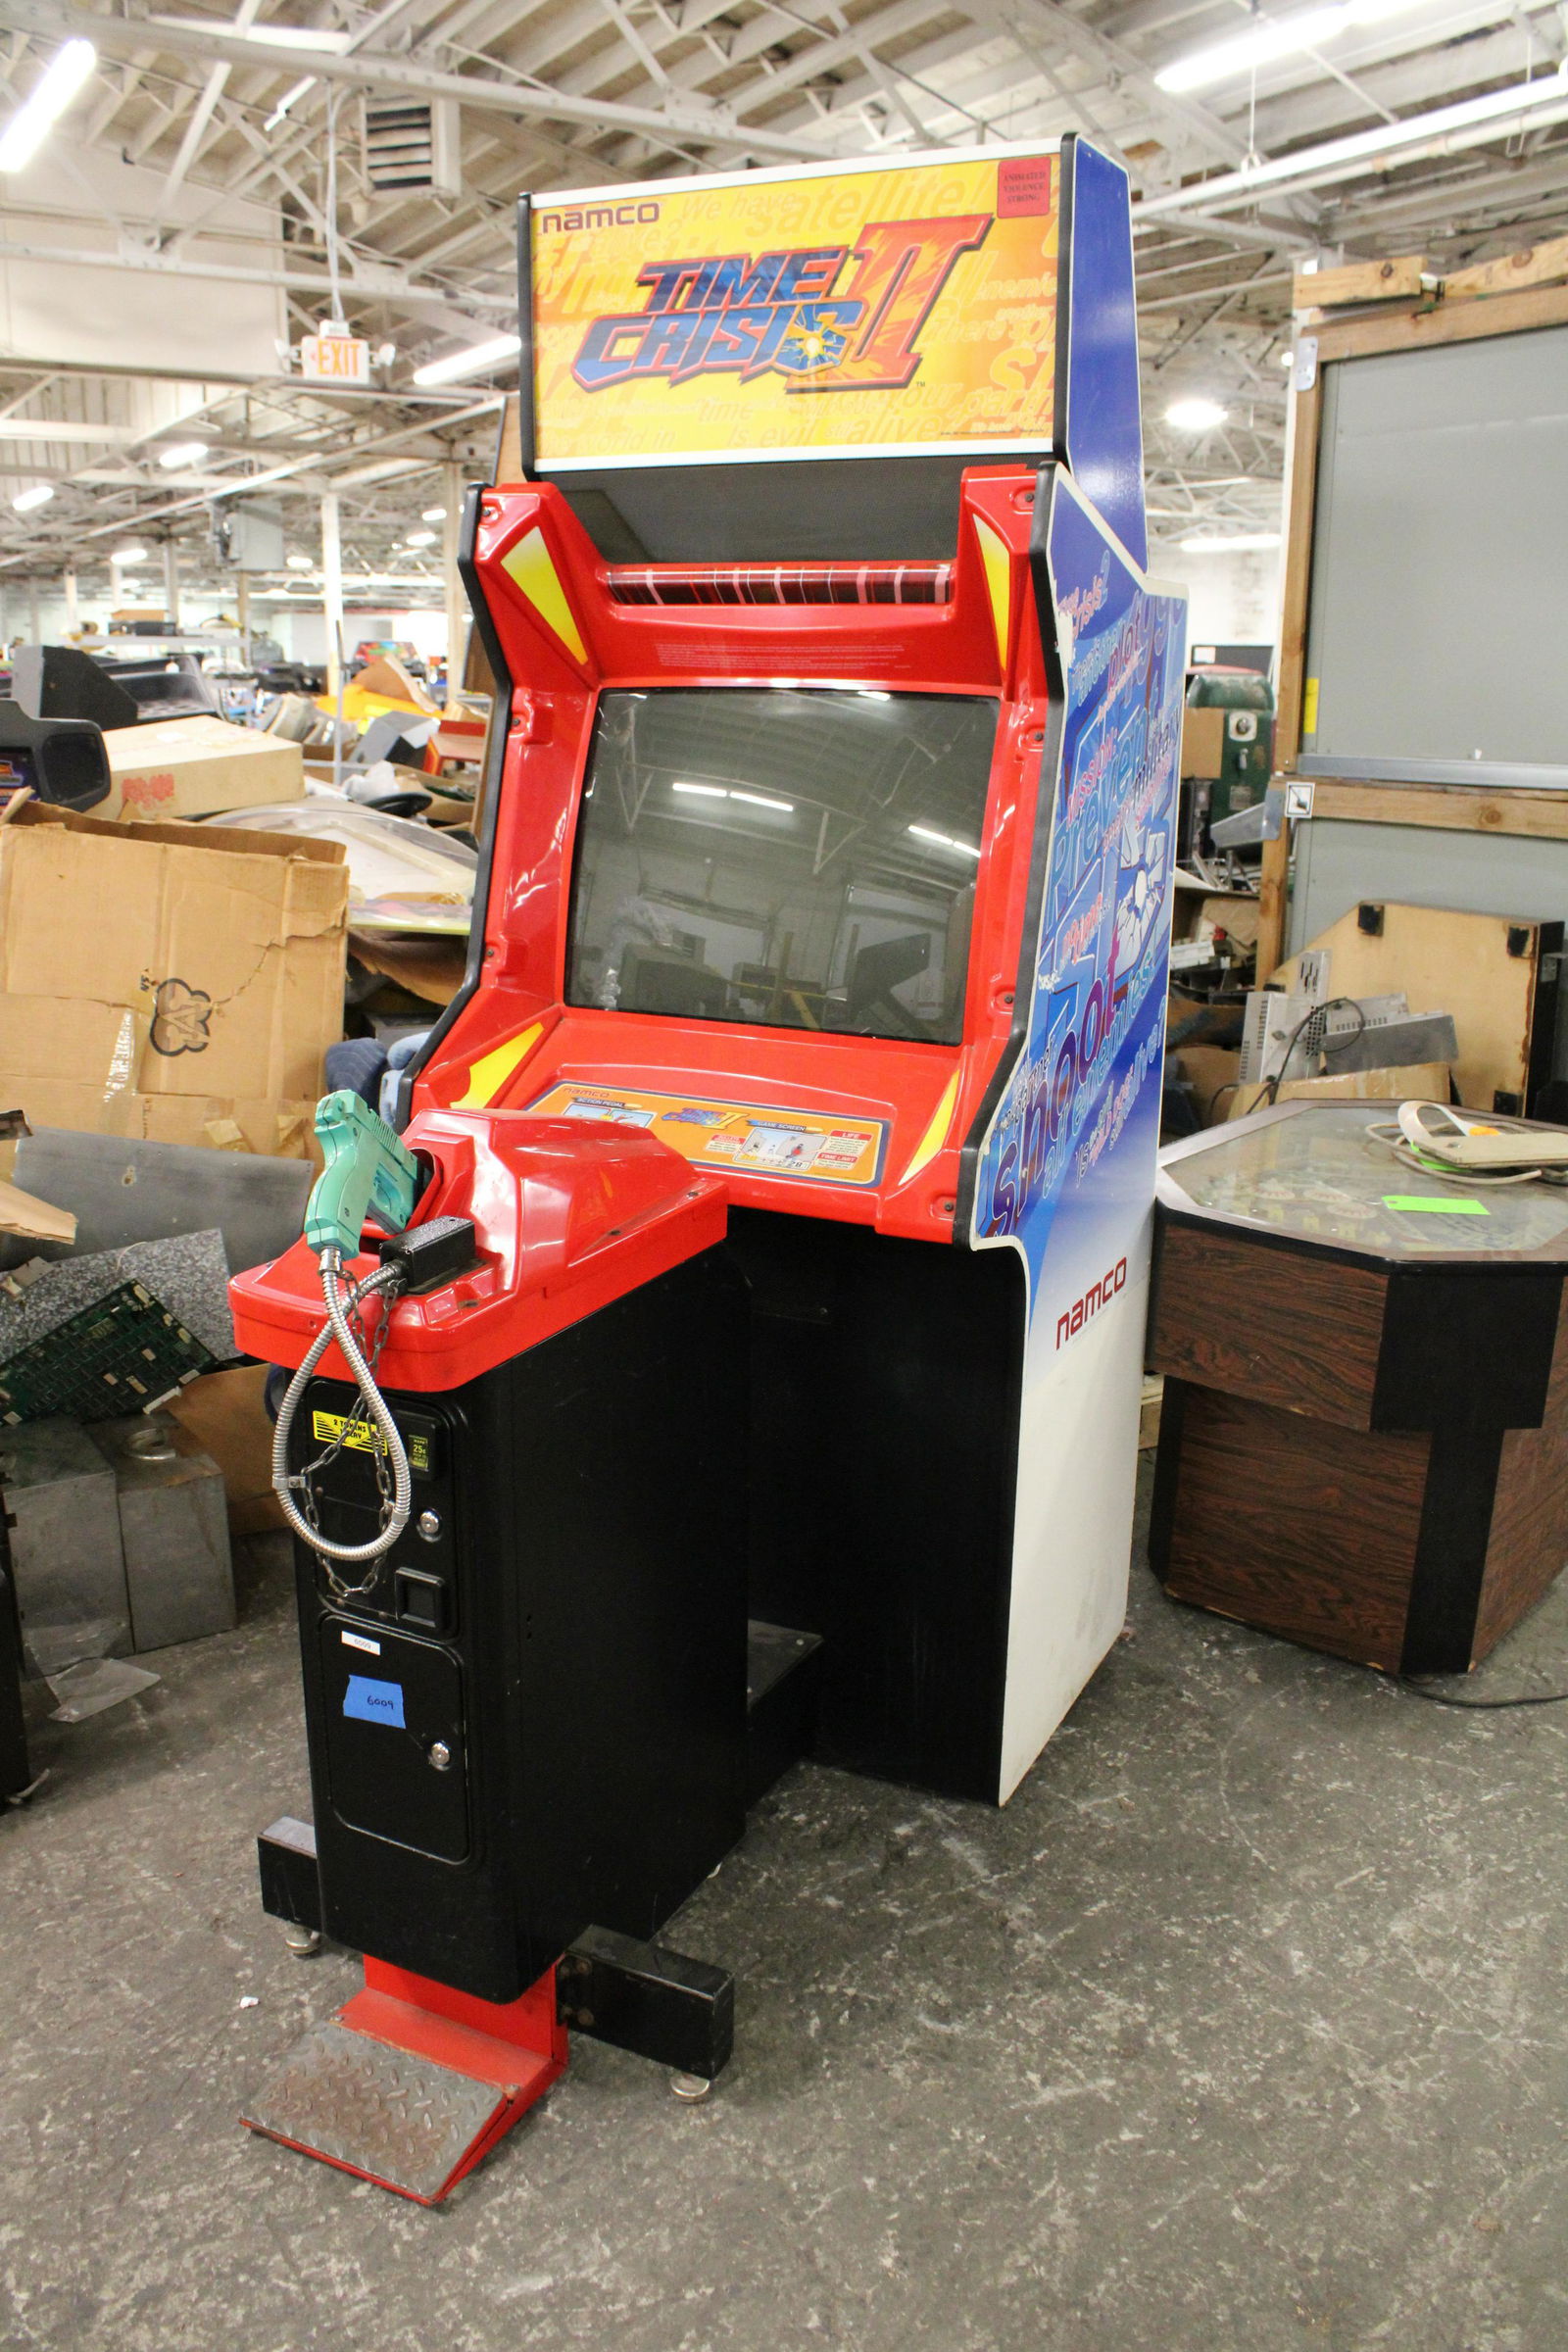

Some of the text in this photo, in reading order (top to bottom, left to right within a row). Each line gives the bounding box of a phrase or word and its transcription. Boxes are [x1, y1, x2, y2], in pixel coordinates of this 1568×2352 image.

[543, 202, 660, 234] namco
[637, 244, 851, 316] TIME
[318, 339, 361, 376] EXIT
[570, 298, 867, 394] CRISIS
[992, 921, 1120, 1240] shoot
[842, 1131, 860, 1140] LIFE
[1056, 1256, 1126, 1350] namco
[367, 1694, 394, 1710] 6009
